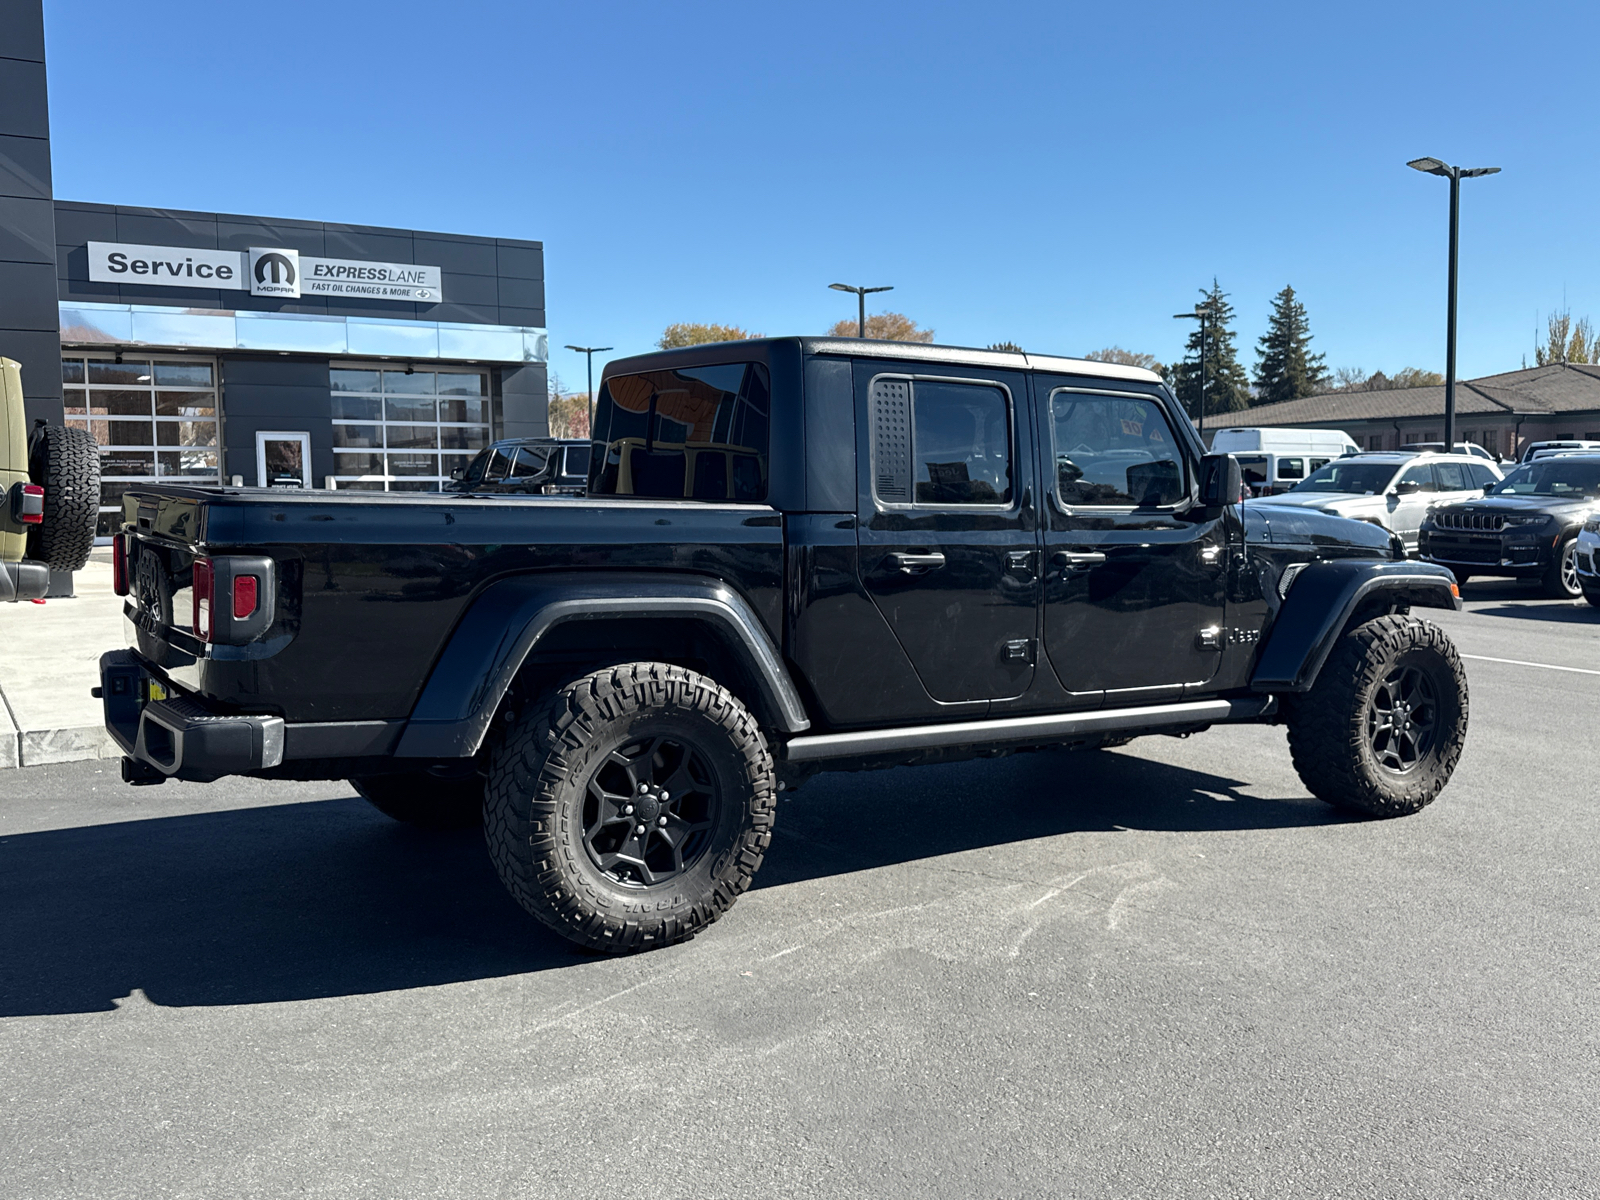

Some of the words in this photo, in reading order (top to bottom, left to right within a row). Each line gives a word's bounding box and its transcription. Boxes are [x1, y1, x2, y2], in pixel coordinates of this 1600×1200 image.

[107, 252, 233, 280] Service
[311, 283, 331, 291] FAST
[332, 284, 344, 292] OIL
[345, 285, 380, 295] CHANGES
[389, 287, 411, 297] MORE
[1229, 628, 1259, 645] Jeep
